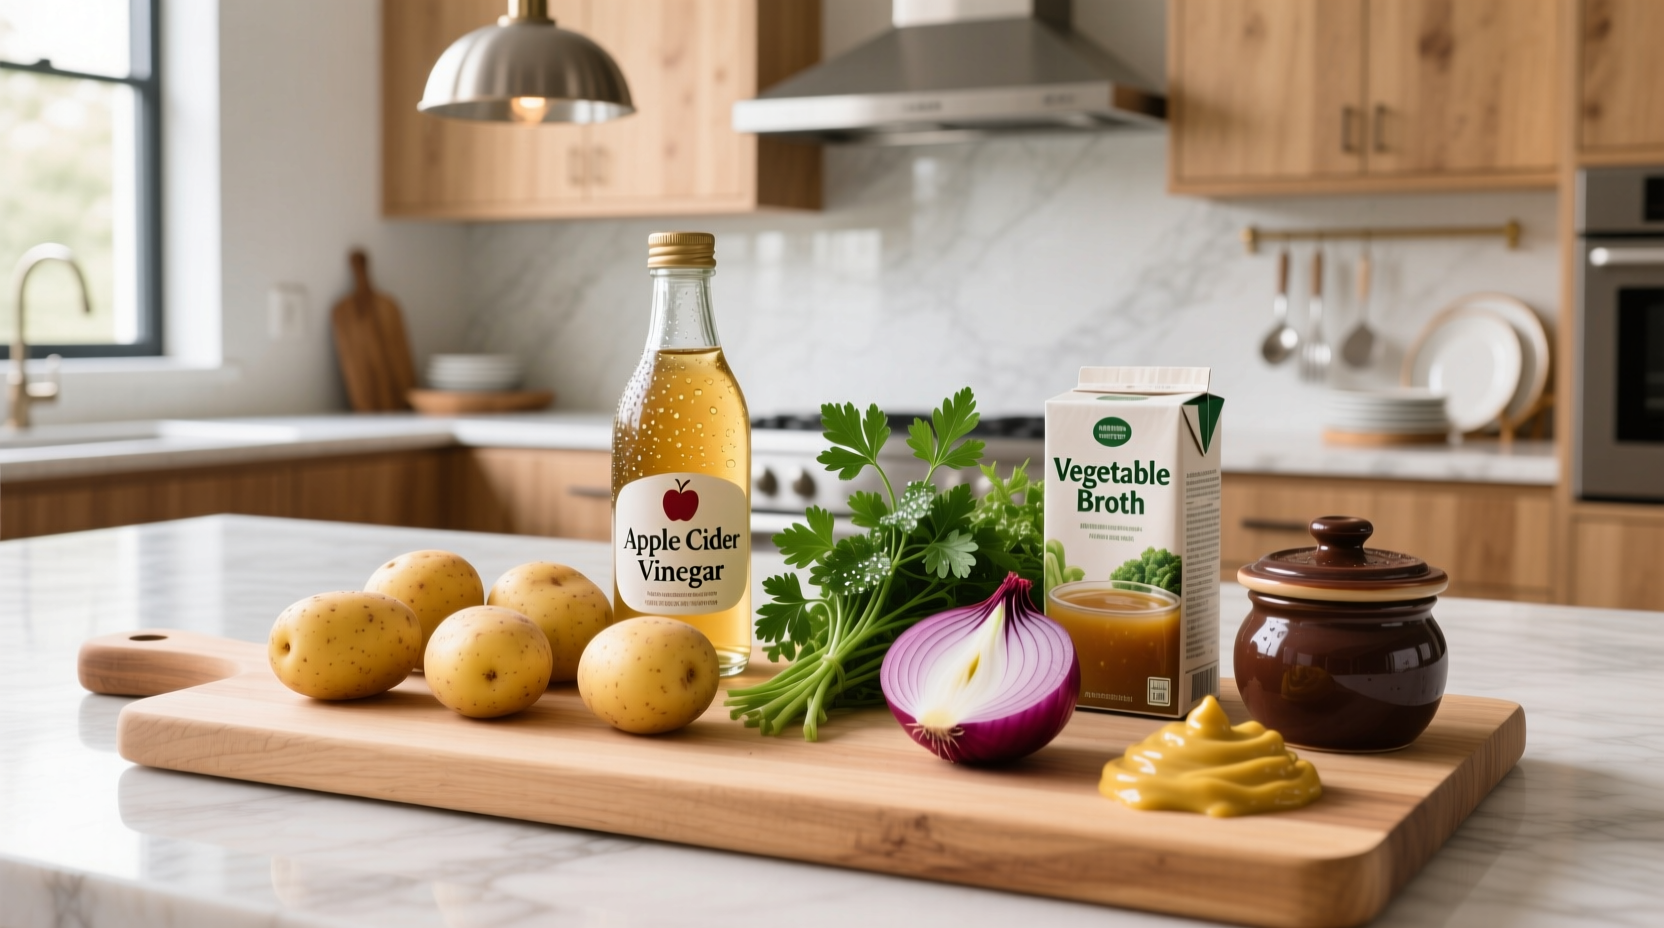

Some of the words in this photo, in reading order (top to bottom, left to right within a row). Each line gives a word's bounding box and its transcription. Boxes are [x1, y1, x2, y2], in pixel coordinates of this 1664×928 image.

[1053, 457, 1171, 489] Vegetable
[1077, 489, 1145, 515] Broth
[624, 527, 681, 557] Apple
[685, 526, 740, 551] Cider
[638, 560, 725, 589] Vinegar
